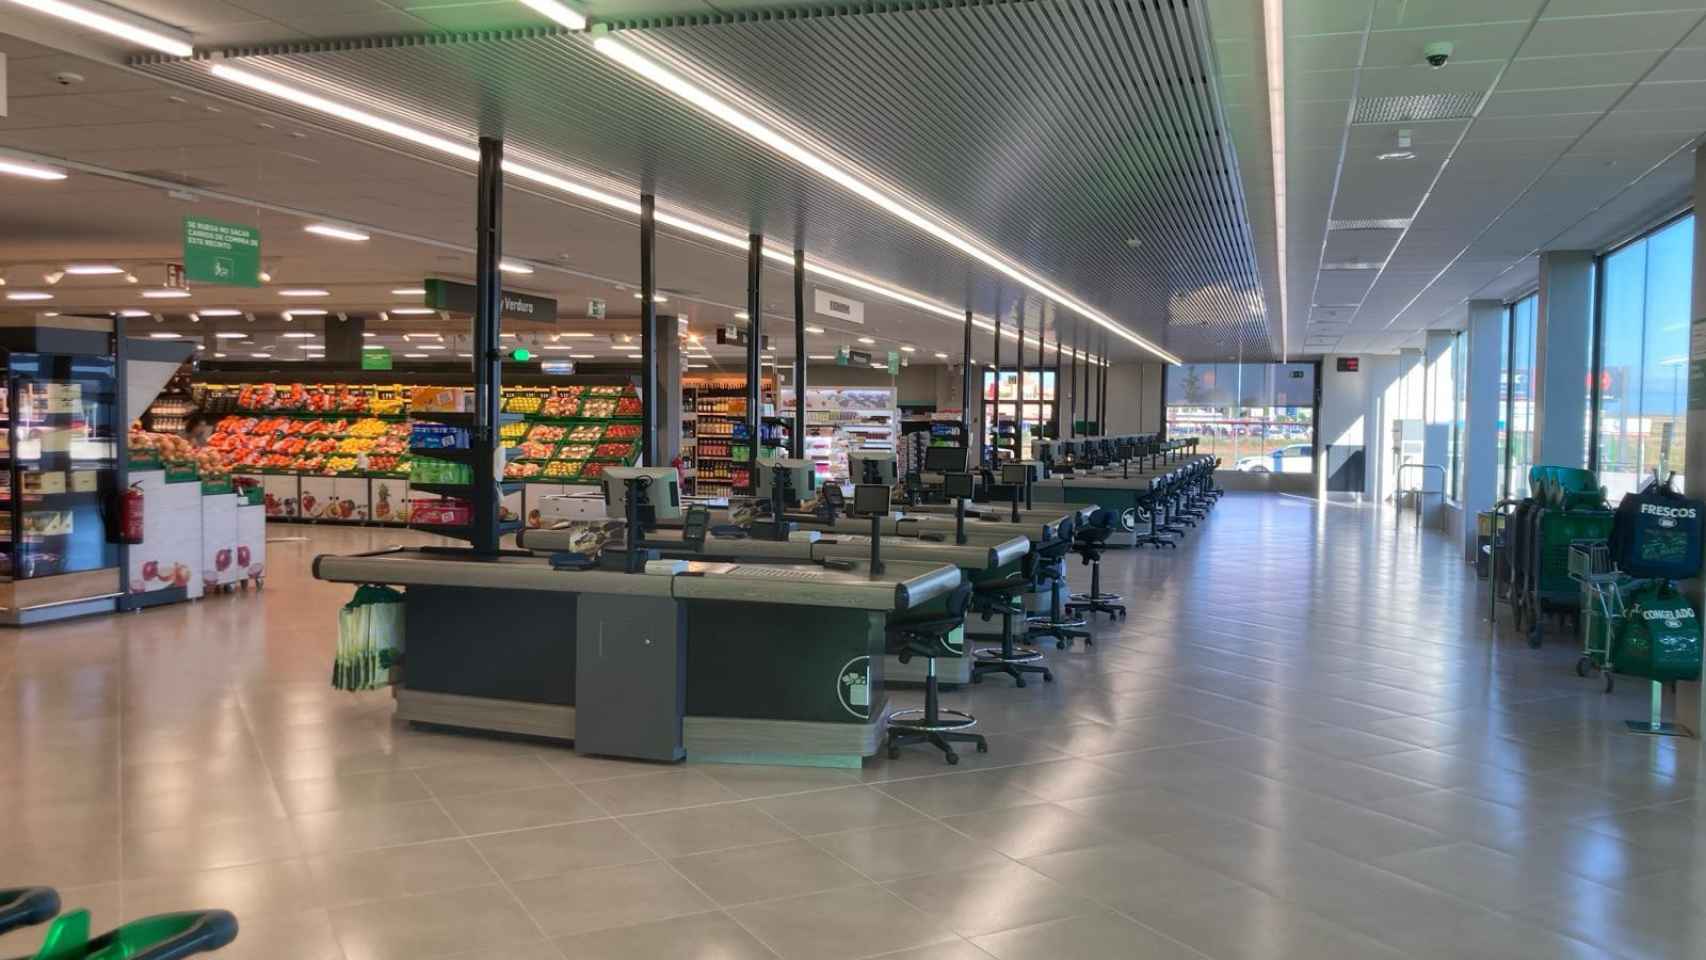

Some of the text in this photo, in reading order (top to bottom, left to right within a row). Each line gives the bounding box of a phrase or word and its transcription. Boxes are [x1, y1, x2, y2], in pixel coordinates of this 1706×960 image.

[504, 296, 534, 313] Verdura
[1641, 503, 1697, 519] FRESCOS
[1643, 607, 1695, 620] CONGELADO
